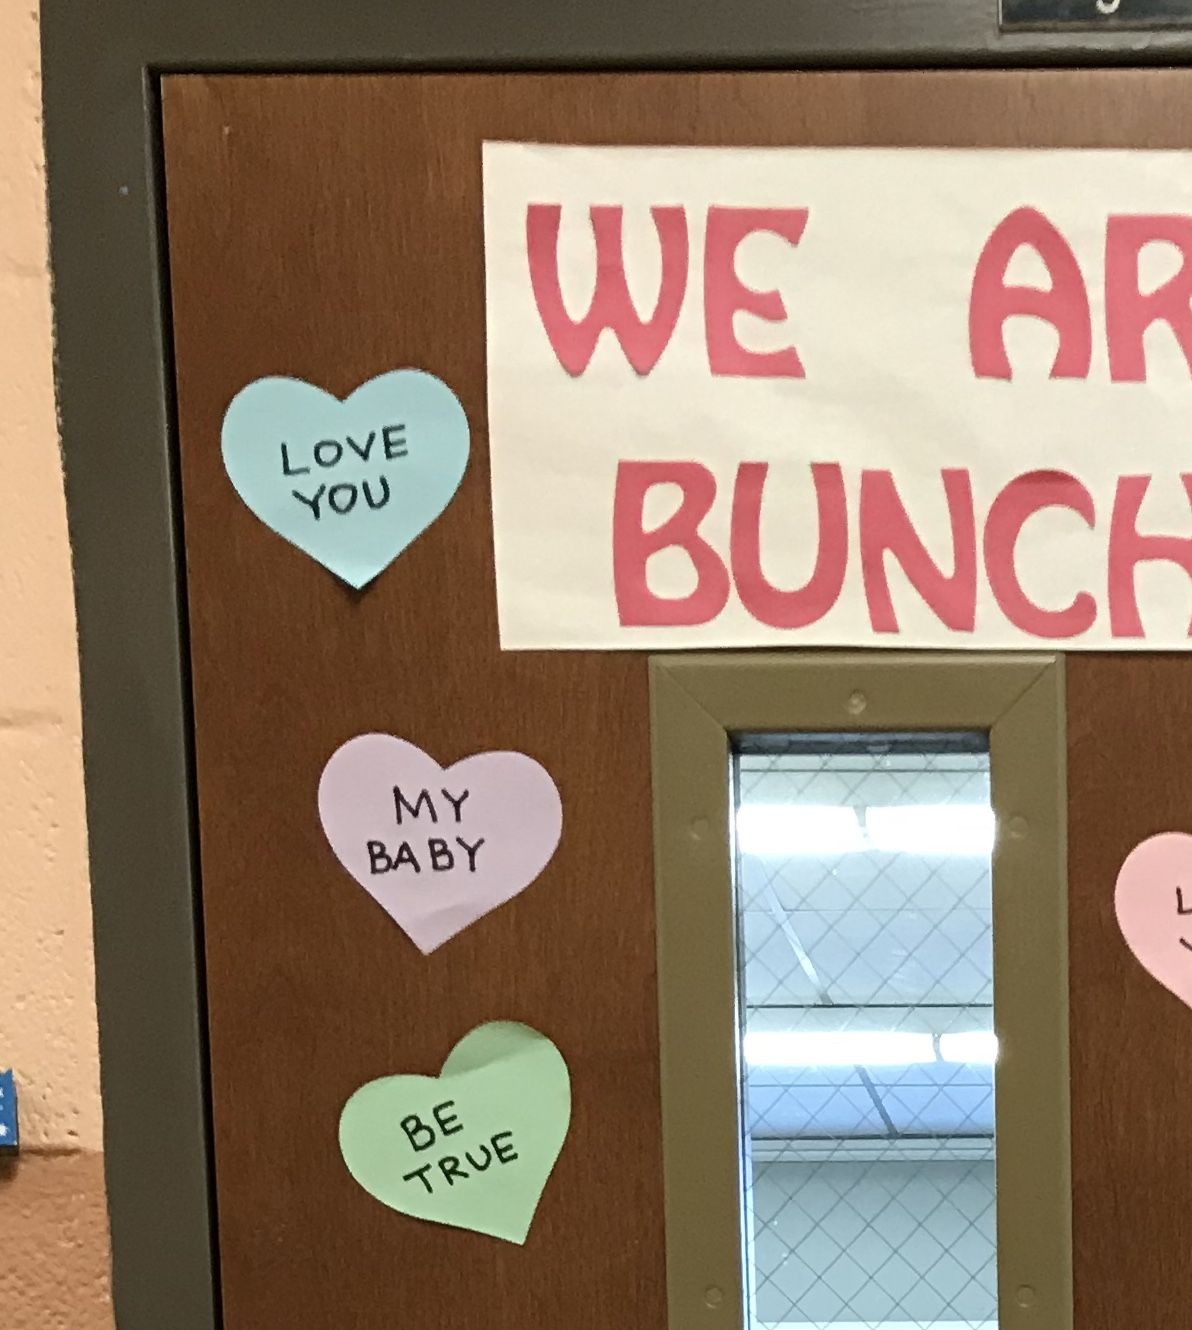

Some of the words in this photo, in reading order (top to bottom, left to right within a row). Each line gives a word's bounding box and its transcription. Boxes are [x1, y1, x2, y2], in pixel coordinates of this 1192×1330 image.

[526, 204, 806, 377] WE
[280, 424, 409, 476] LOVE
[291, 474, 391, 521] YOU
[392, 785, 470, 826] MY
[366, 836, 486, 876] BABY
[399, 1099, 464, 1153] BE
[401, 1129, 520, 1196] TRUE
